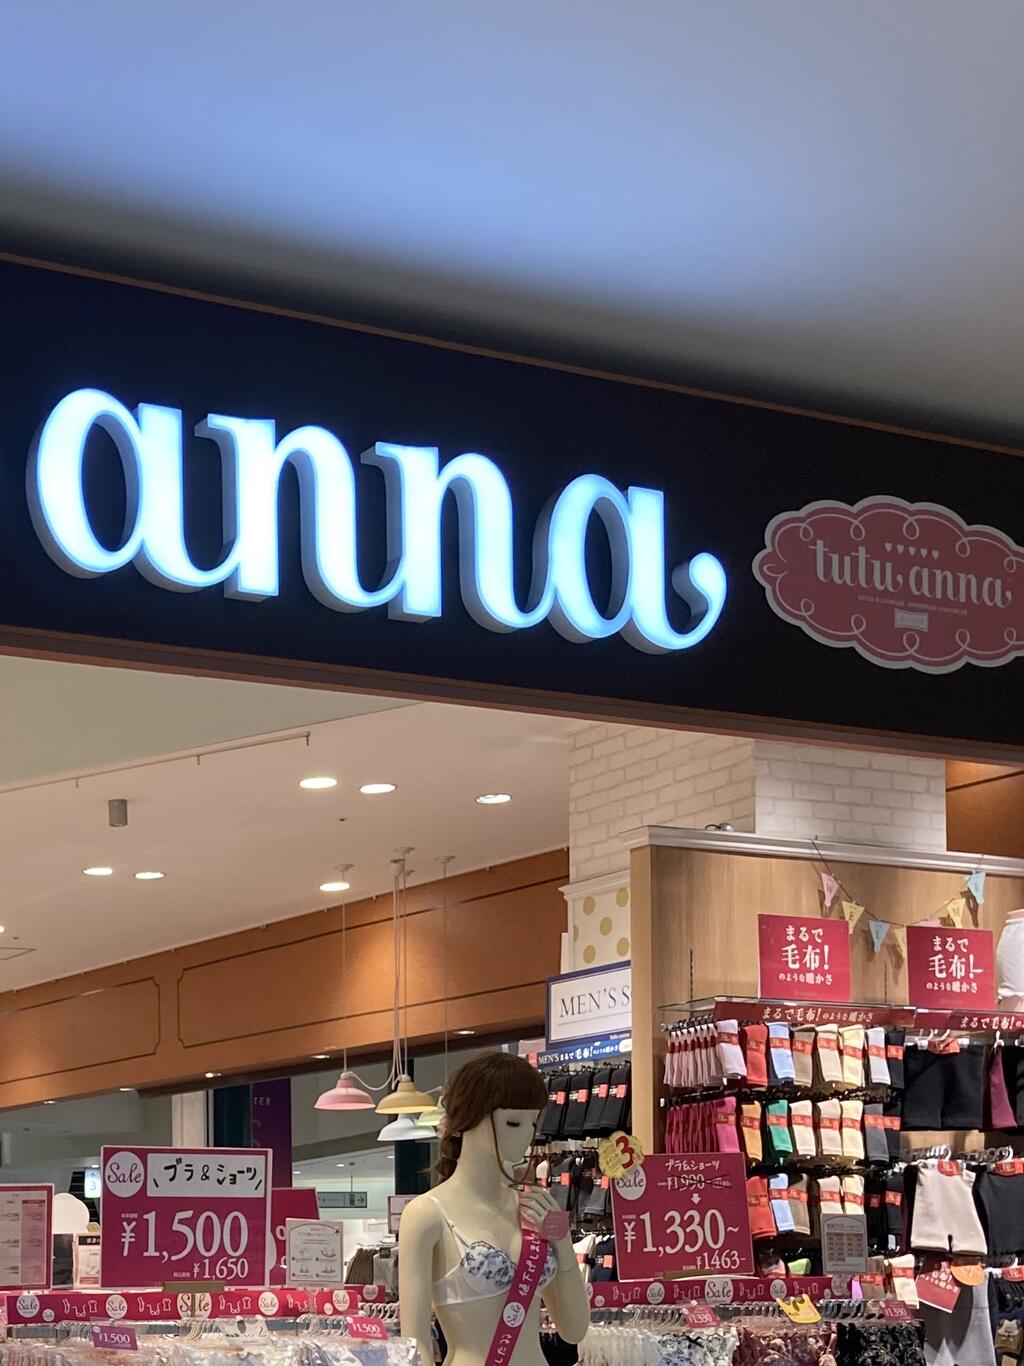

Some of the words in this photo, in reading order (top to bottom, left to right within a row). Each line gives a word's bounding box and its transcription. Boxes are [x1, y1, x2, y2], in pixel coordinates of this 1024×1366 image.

[25, 387, 728, 655] anna
[808, 539, 903, 593] tutu
[908, 565, 1013, 609] anna
[785, 925, 824, 943] まるで
[932, 935, 970, 952] まるで
[780, 944, 831, 971] 毛布!
[778, 971, 834, 986] のような暖かさ
[926, 980, 978, 993] のような暖かさ
[107, 1162, 142, 1184] Sale
[121, 1209, 249, 1264] ¥1,500
[193, 1257, 249, 1281] ¥1,650
